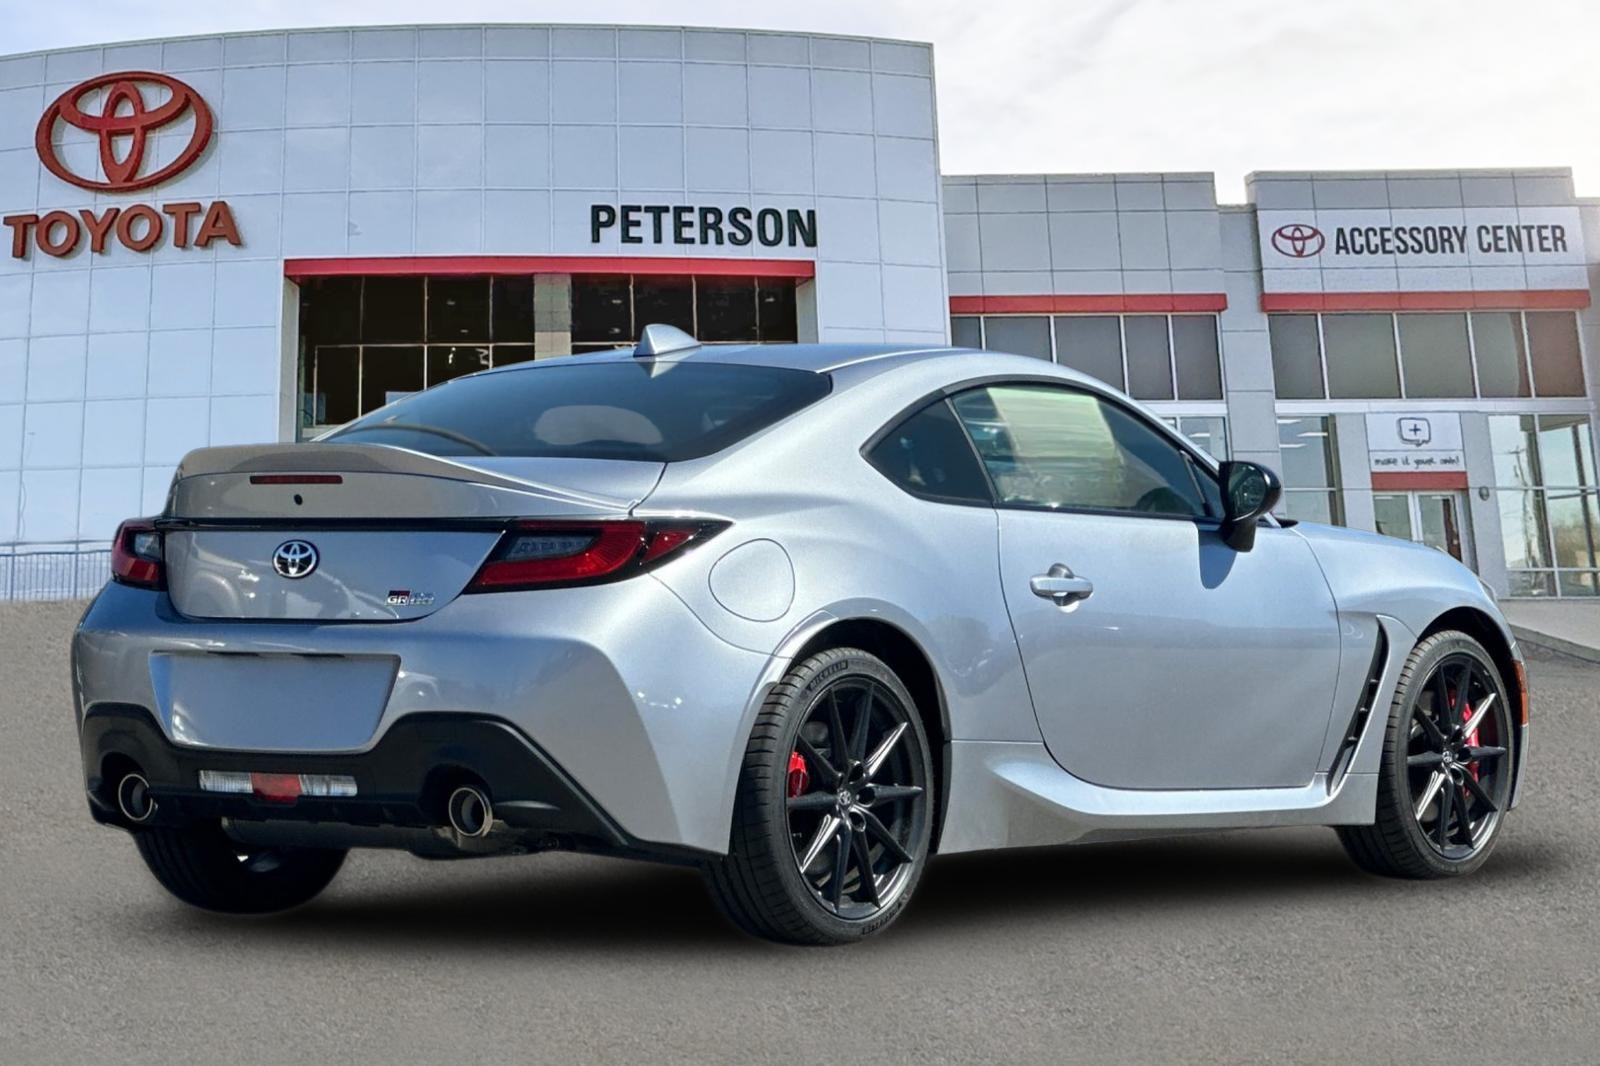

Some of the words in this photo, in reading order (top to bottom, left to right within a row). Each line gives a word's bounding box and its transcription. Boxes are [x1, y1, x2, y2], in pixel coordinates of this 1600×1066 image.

[3, 200, 242, 258] TOYOTA
[590, 205, 817, 248] PETERSON
[1335, 225, 1467, 255] ACCESSORY
[1477, 224, 1568, 253] CENTER
